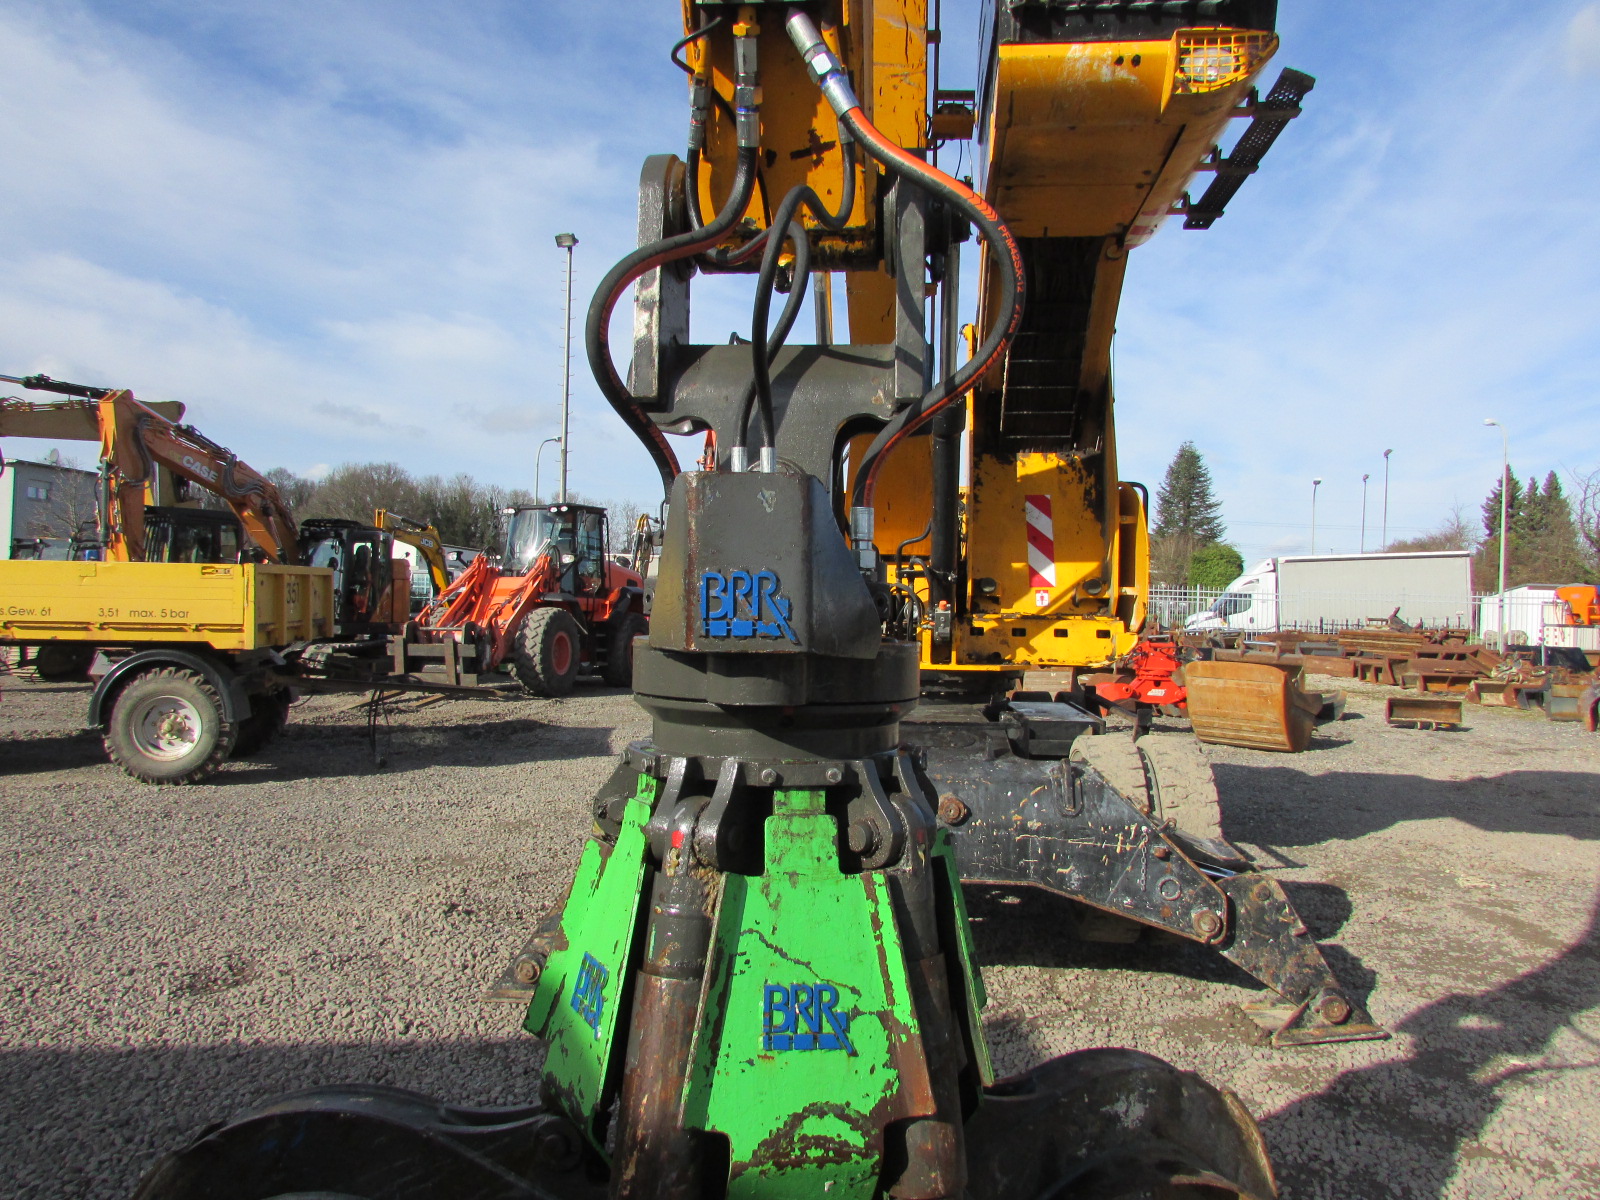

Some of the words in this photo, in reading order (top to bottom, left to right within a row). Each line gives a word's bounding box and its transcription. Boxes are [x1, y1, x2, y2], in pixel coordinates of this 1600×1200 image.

[182, 455, 219, 483] CASE
[421, 538, 434, 548] JCB
[40, 606, 51, 617] 6t
[129, 609, 157, 618] max.
[160, 608, 168, 618] 5
[170, 608, 190, 619] bar
[700, 570, 798, 643] BRR
[762, 983, 858, 1057] BRR
